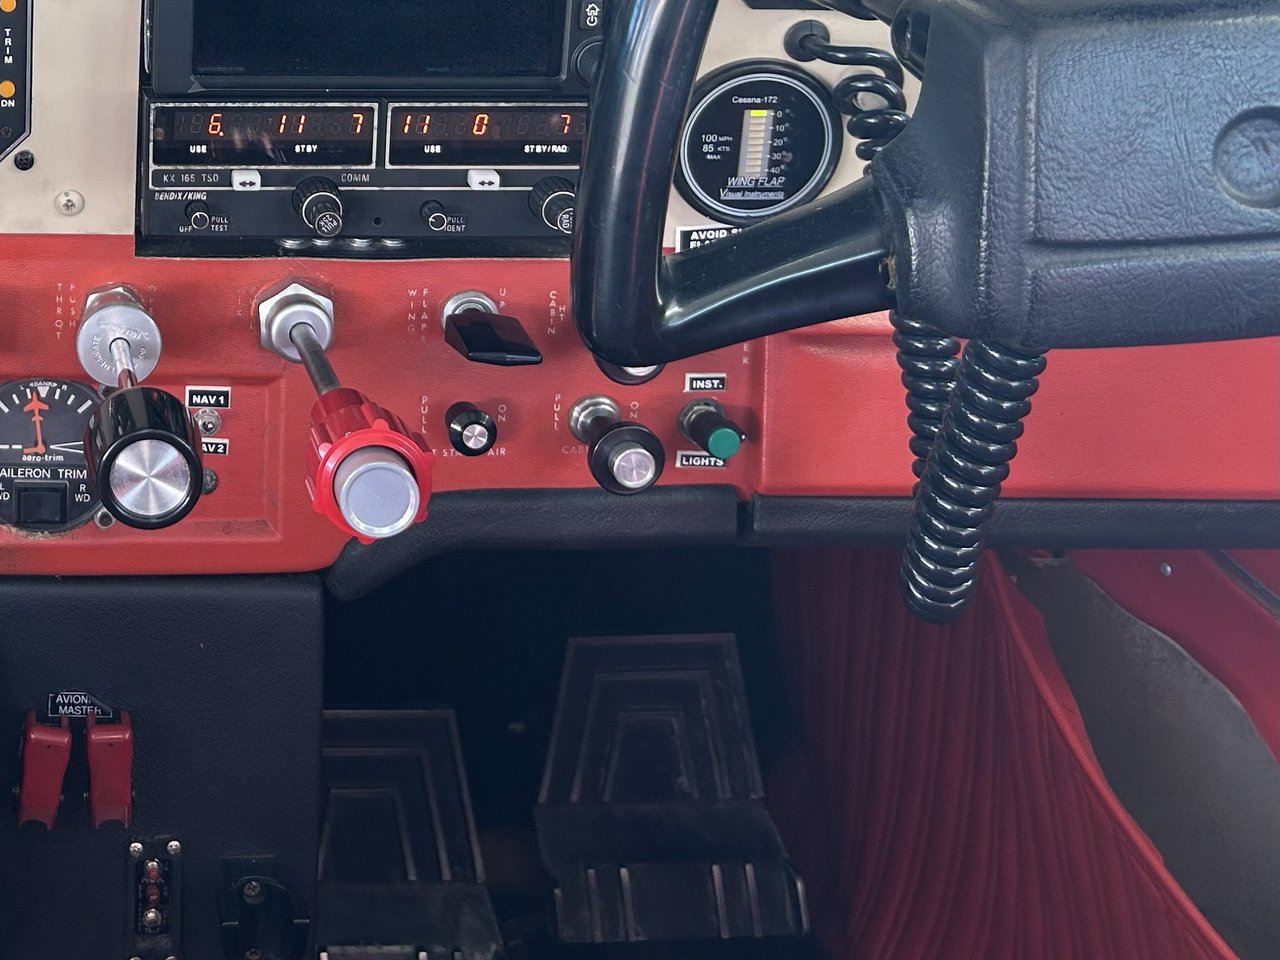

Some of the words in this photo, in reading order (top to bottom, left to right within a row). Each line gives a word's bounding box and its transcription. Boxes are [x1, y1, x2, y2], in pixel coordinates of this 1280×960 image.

[190, 145, 207, 153] USE
[692, 379, 722, 389] INST.
[192, 394, 213, 404] NAV
[218, 394, 225, 404] 1
[682, 456, 724, 466] LIGHTS
[0, 468, 50, 478] AILERON
[58, 468, 87, 479] TRIM
[56, 695, 91, 703] AVION
